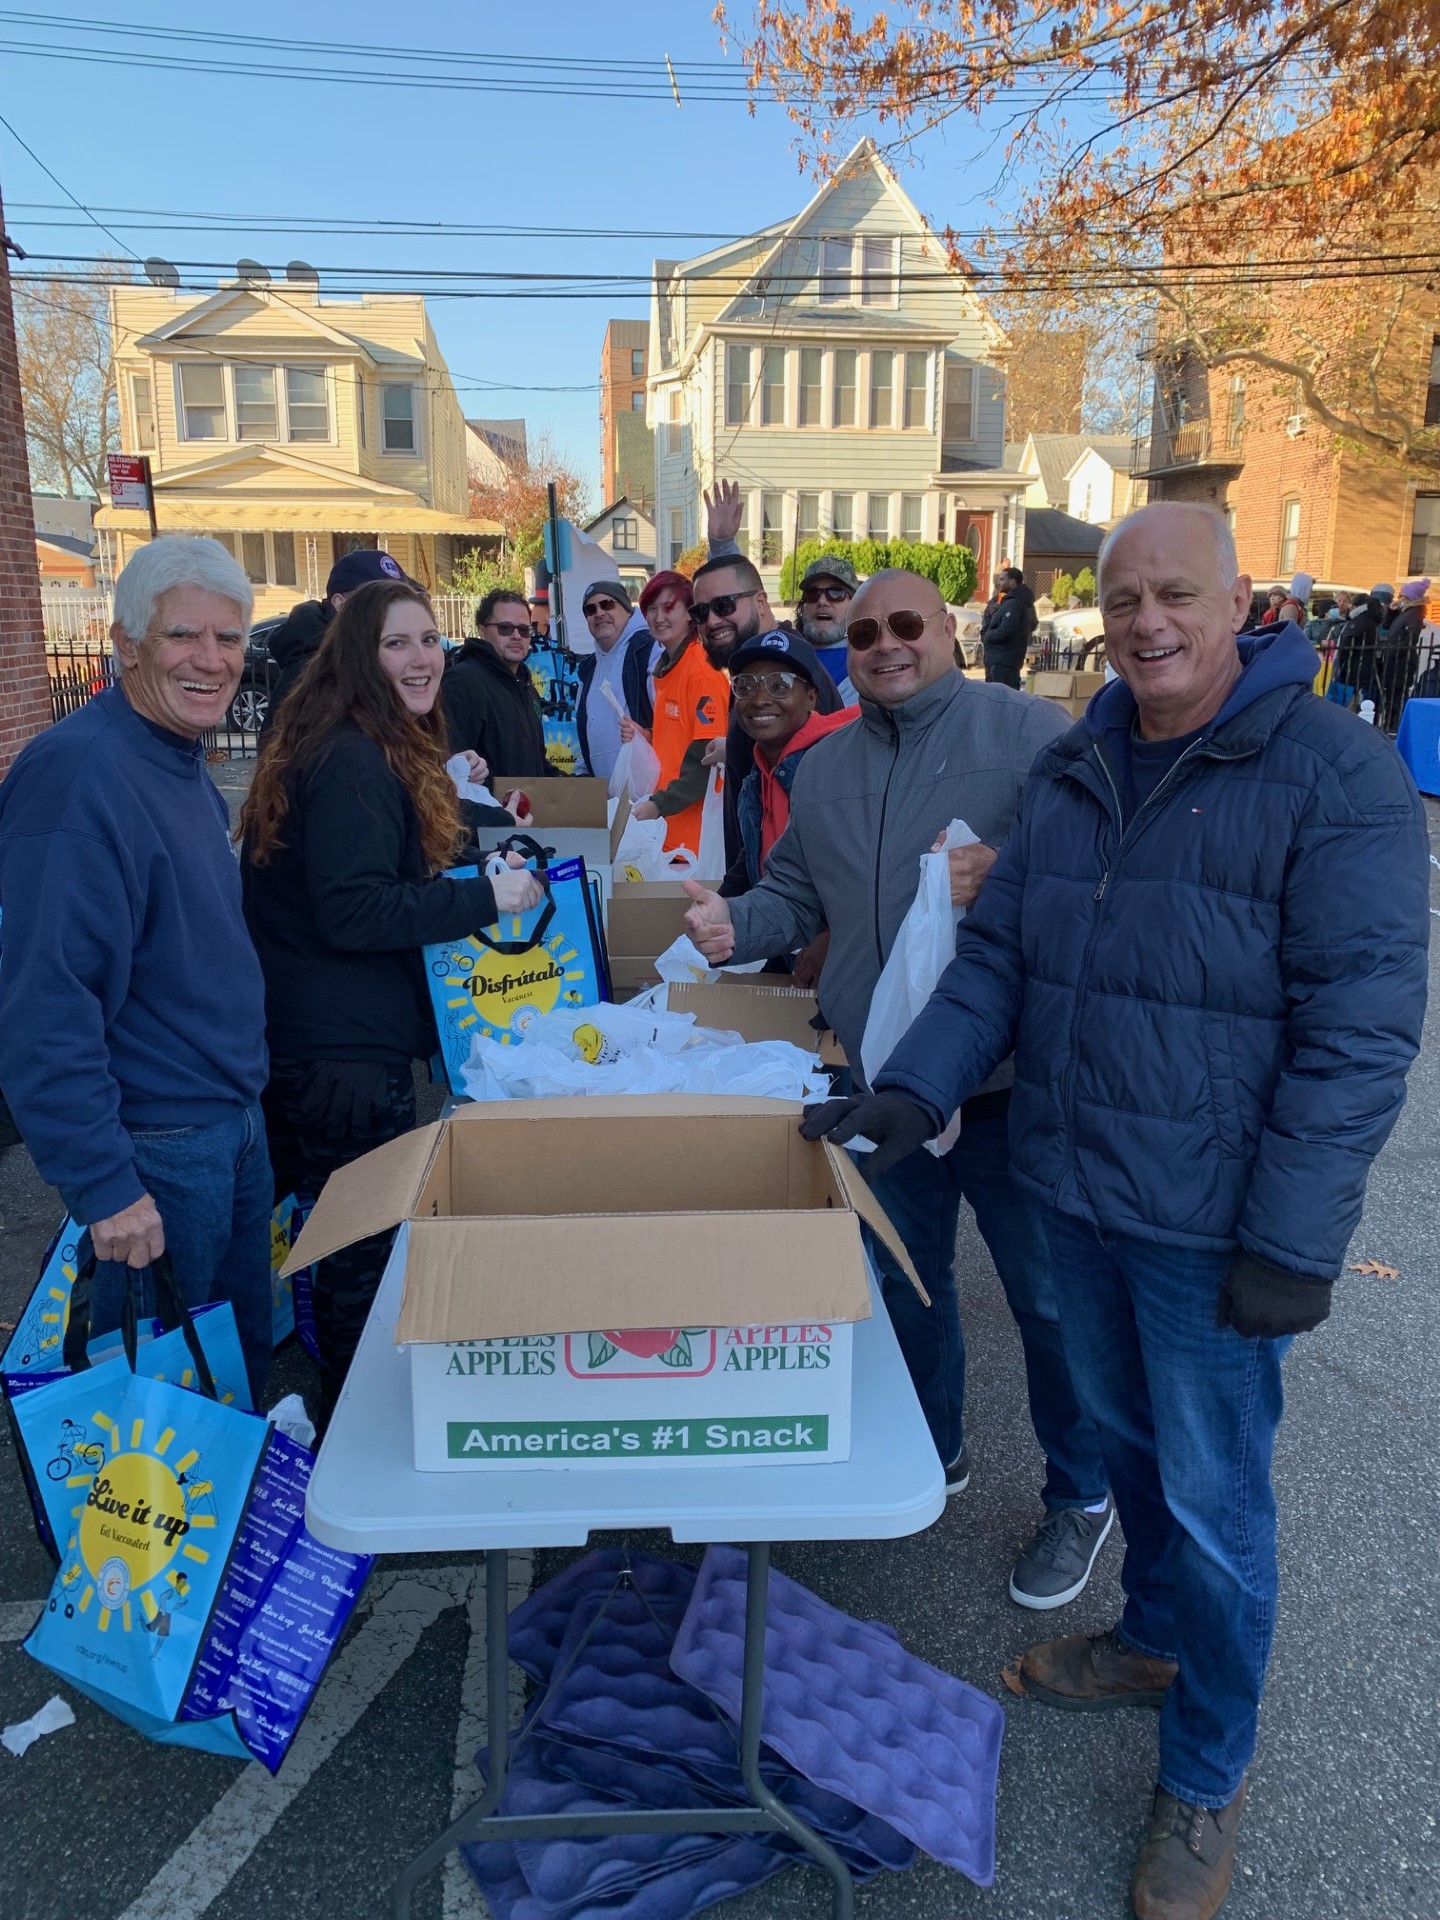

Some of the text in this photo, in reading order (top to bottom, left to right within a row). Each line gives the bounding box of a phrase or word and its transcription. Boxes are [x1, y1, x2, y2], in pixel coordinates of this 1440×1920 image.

[462, 962, 565, 998] Disfrútalo
[724, 1324, 832, 1345] APPLES
[445, 1350, 556, 1376] APPLES
[722, 1344, 831, 1371] APPLES
[462, 1423, 814, 1452] America's #1 Snack
[86, 1476, 190, 1547] Live it up
[100, 1524, 151, 1551] Get Vaccinated
